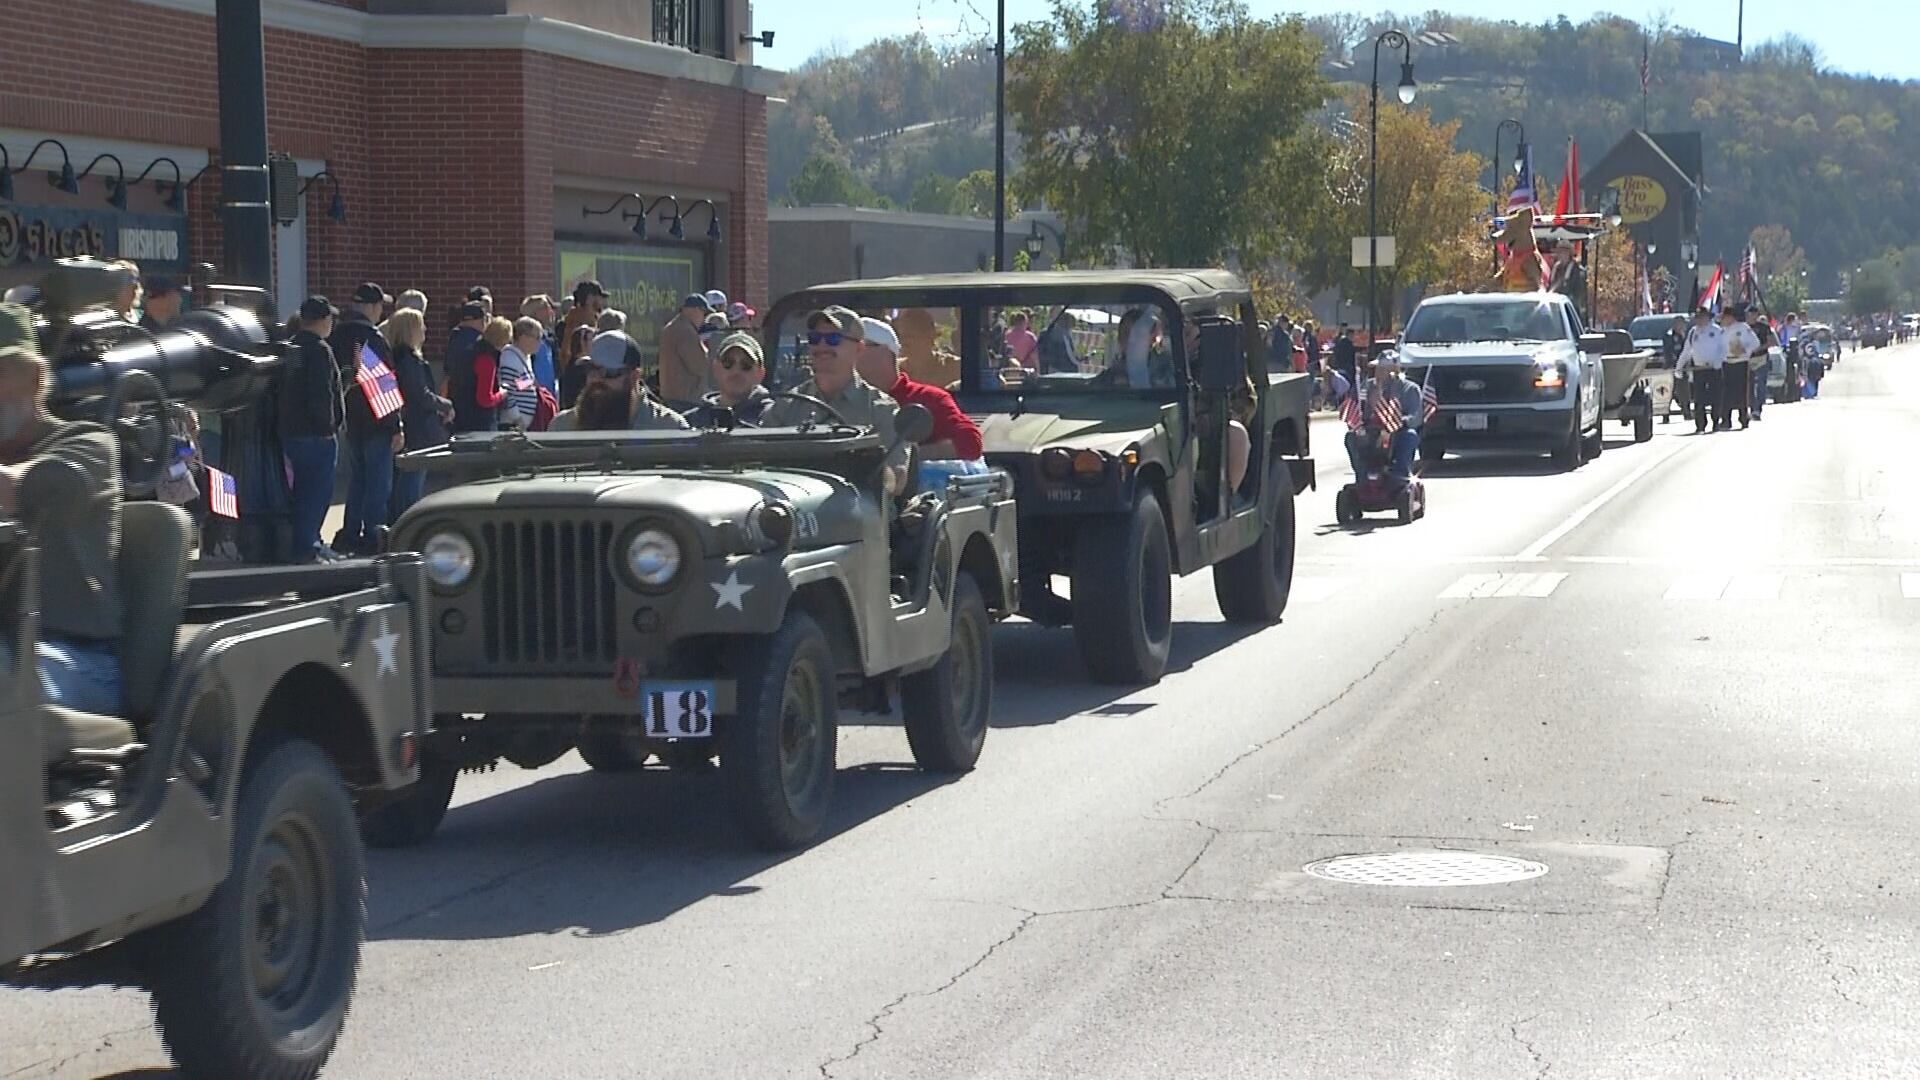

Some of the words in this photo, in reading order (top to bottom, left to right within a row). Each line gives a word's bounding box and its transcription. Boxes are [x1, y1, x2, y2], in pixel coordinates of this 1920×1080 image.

[1623, 177, 1653, 190] Bass
[1623, 190, 1646, 203] Pro
[121, 228, 154, 258] IRISH
[156, 230, 178, 260] PUB
[650, 691, 708, 734] 18
